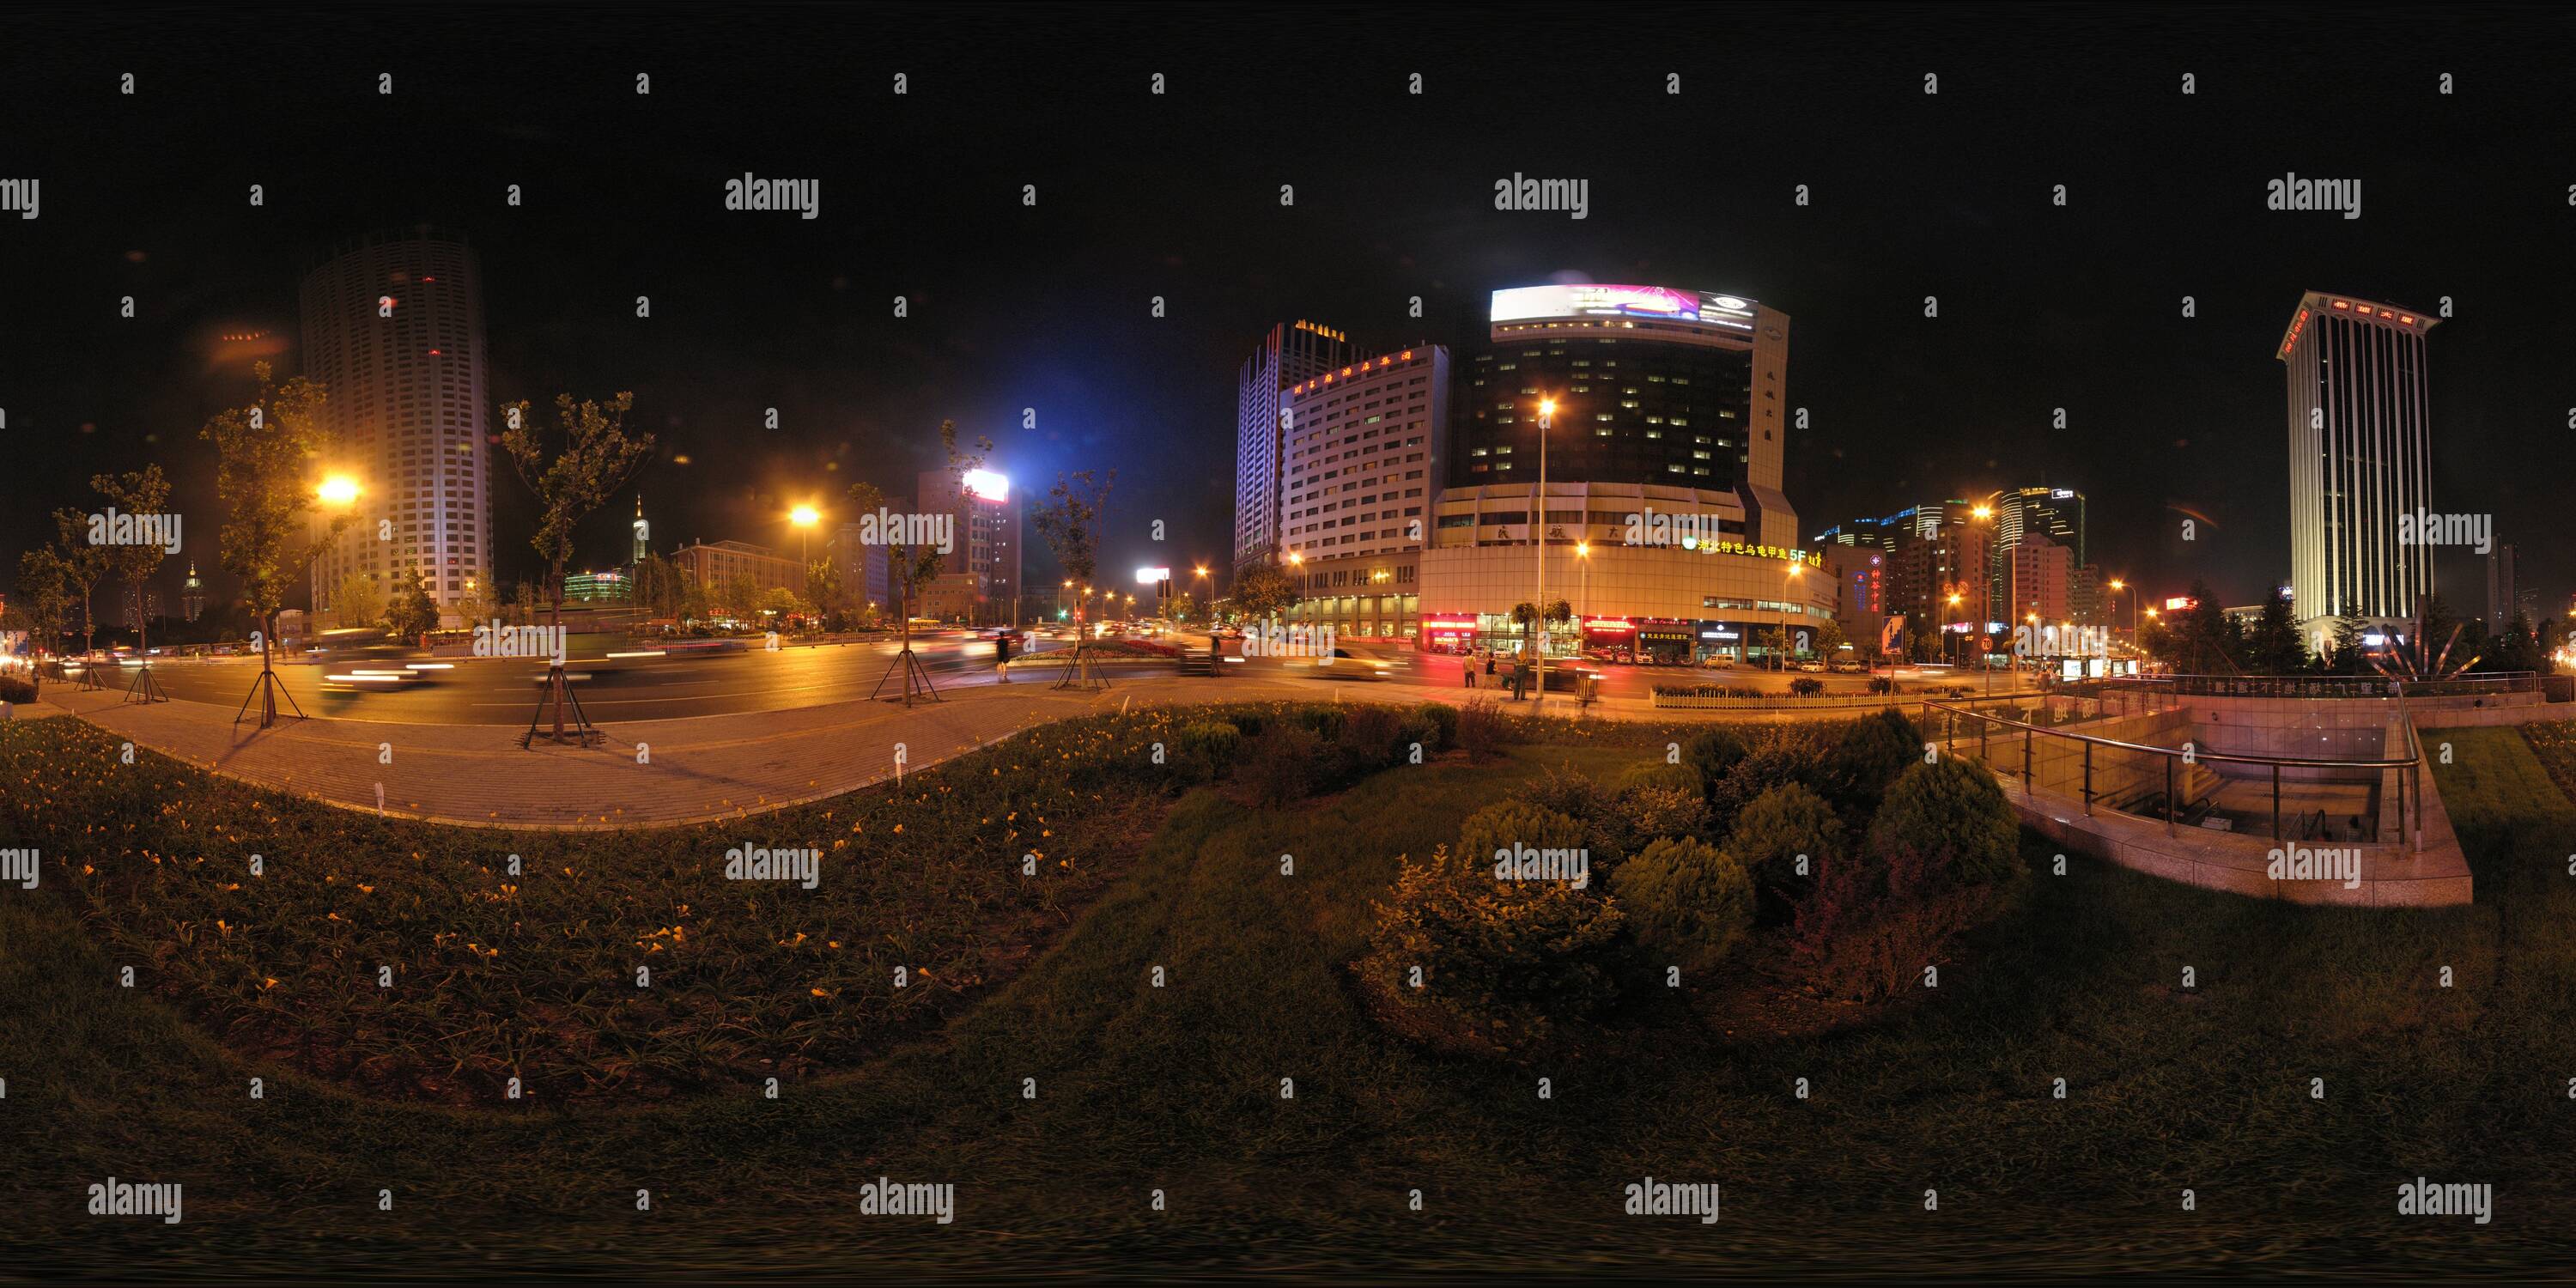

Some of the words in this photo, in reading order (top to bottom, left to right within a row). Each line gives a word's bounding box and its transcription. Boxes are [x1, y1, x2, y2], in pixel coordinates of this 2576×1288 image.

[1497, 525, 1674, 542] 民航大
[1789, 549, 1806, 562] 5F
[1984, 640, 1990, 648] 70
